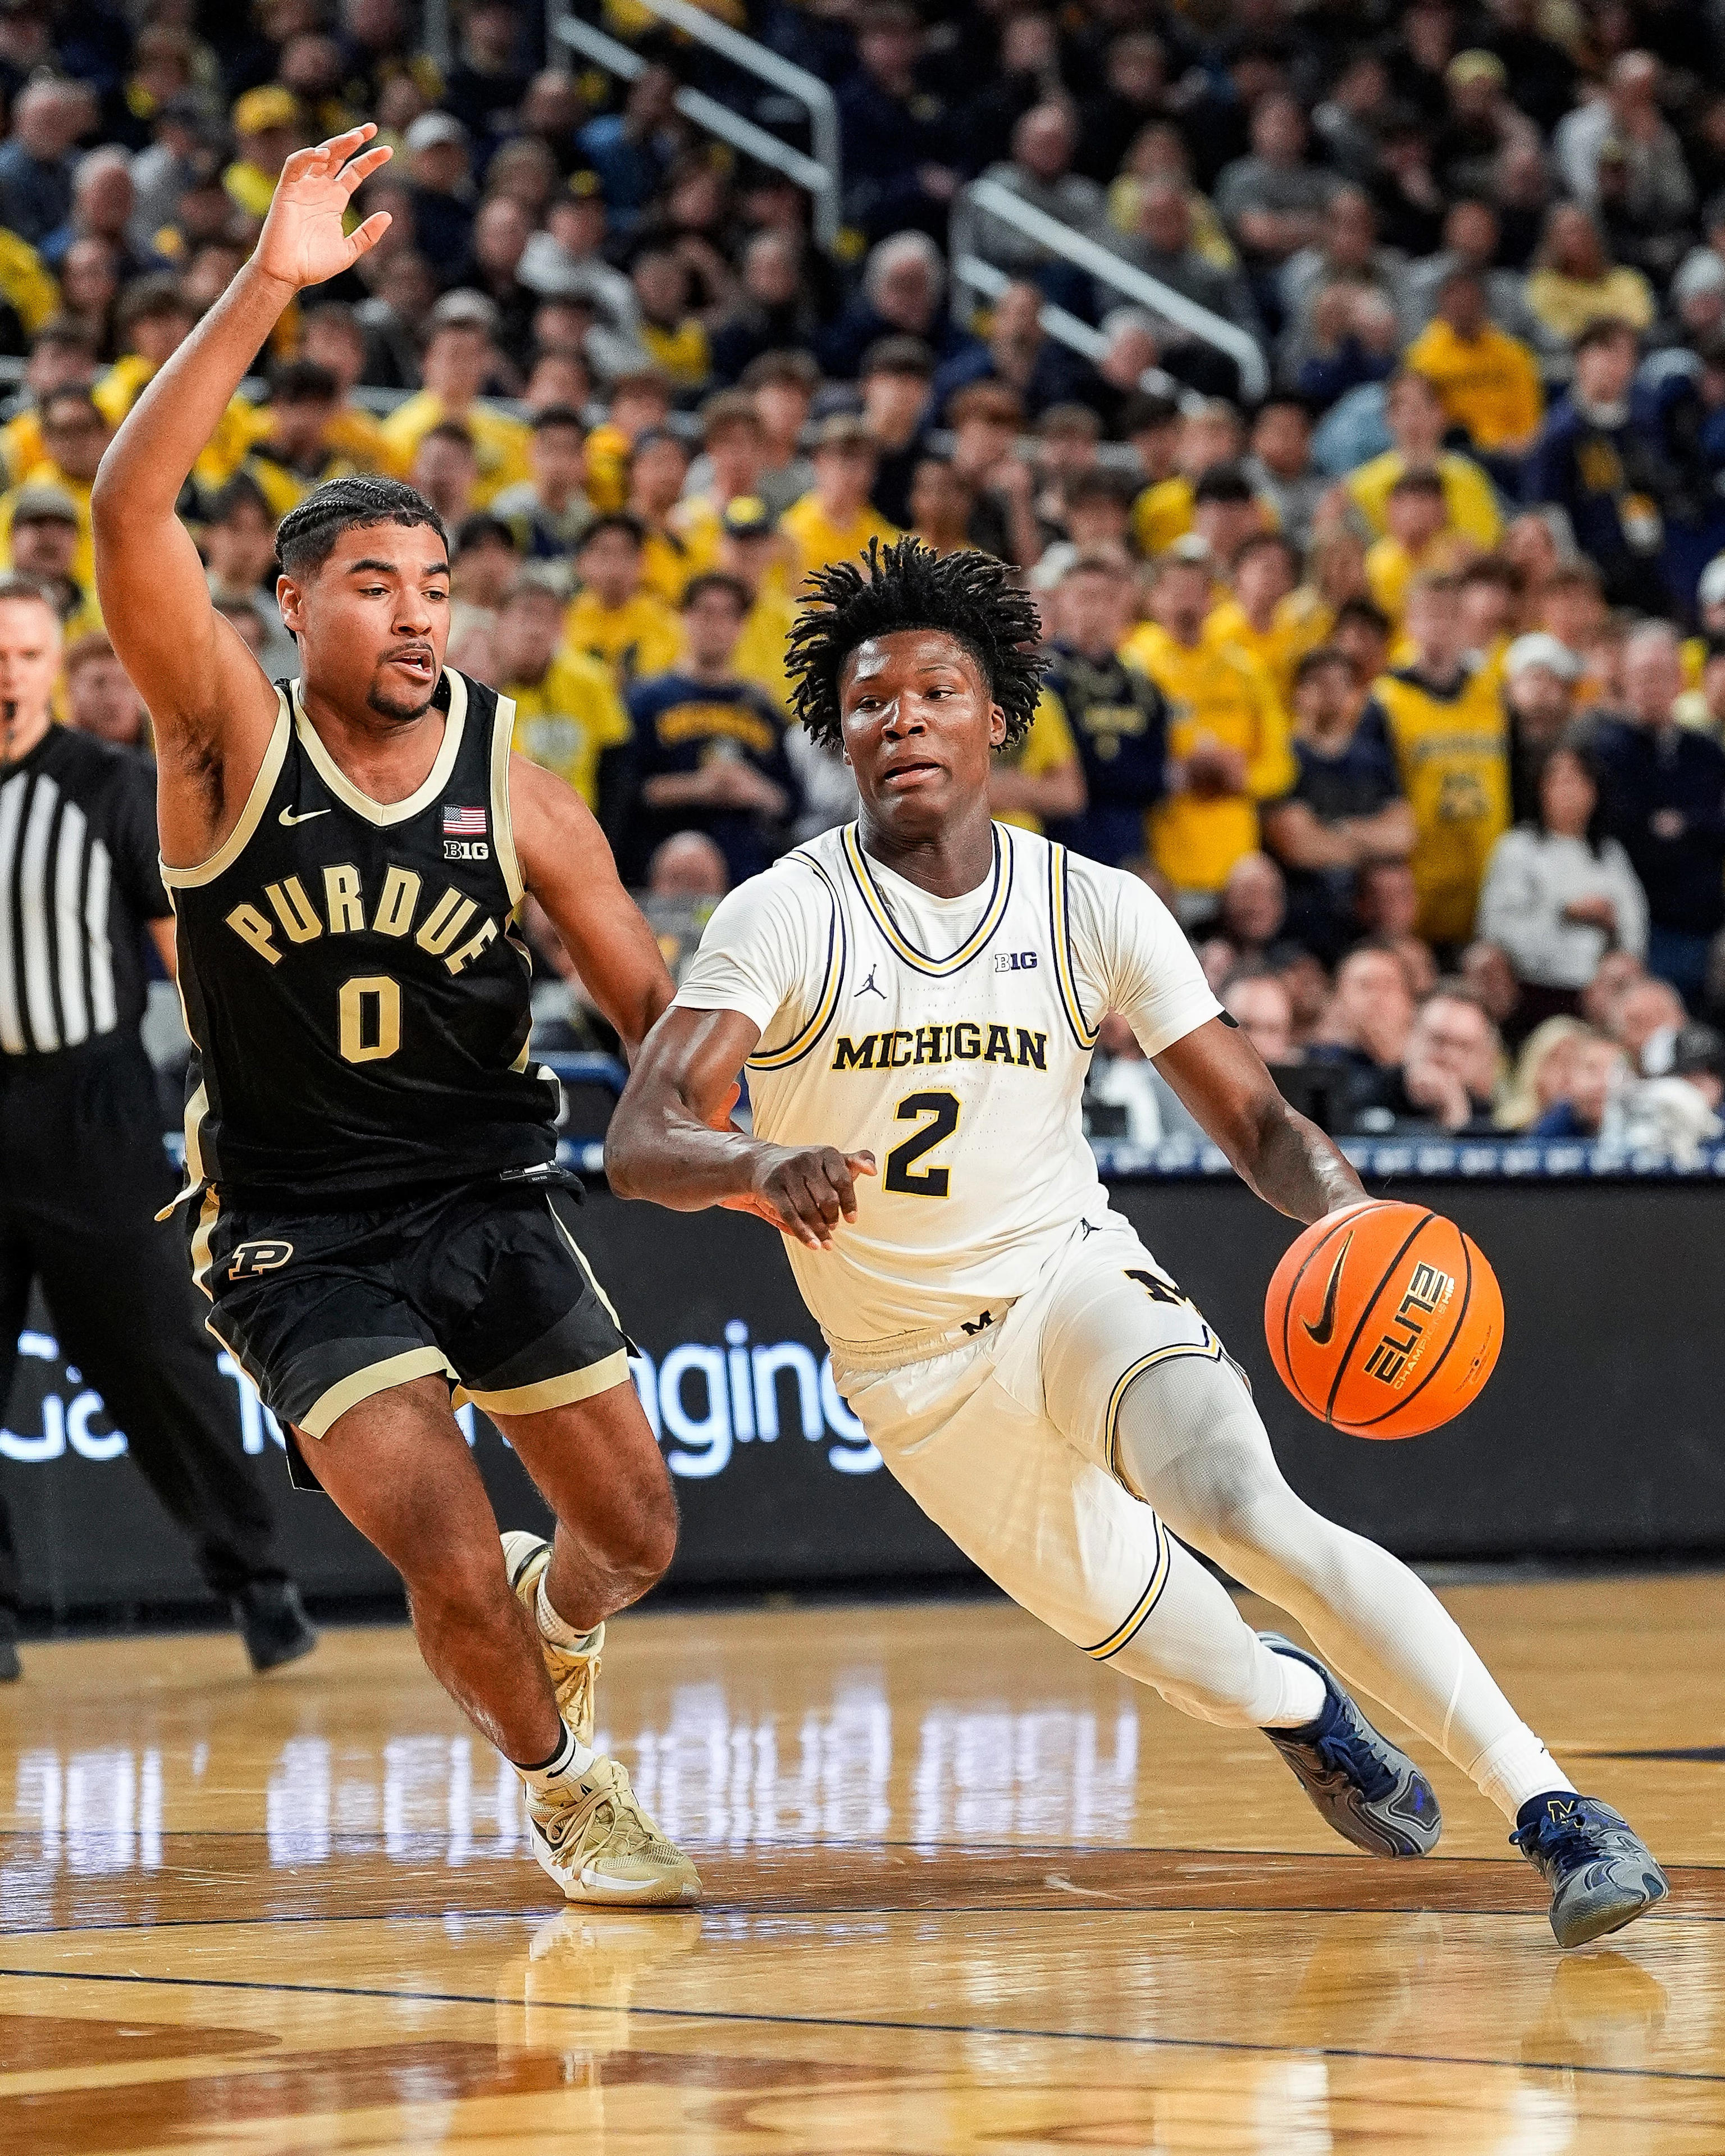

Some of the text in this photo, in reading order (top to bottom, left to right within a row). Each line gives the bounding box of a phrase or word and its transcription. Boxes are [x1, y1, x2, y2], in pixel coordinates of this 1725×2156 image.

[224, 862, 500, 977] PURDUE
[338, 974, 403, 1063] 0
[830, 1021, 1049, 1072] MICHIGAN
[882, 1088, 962, 1199] 2
[229, 1240, 294, 1281] P
[960, 1309, 996, 1337] M
[1363, 1260, 1448, 1386] ELITE
